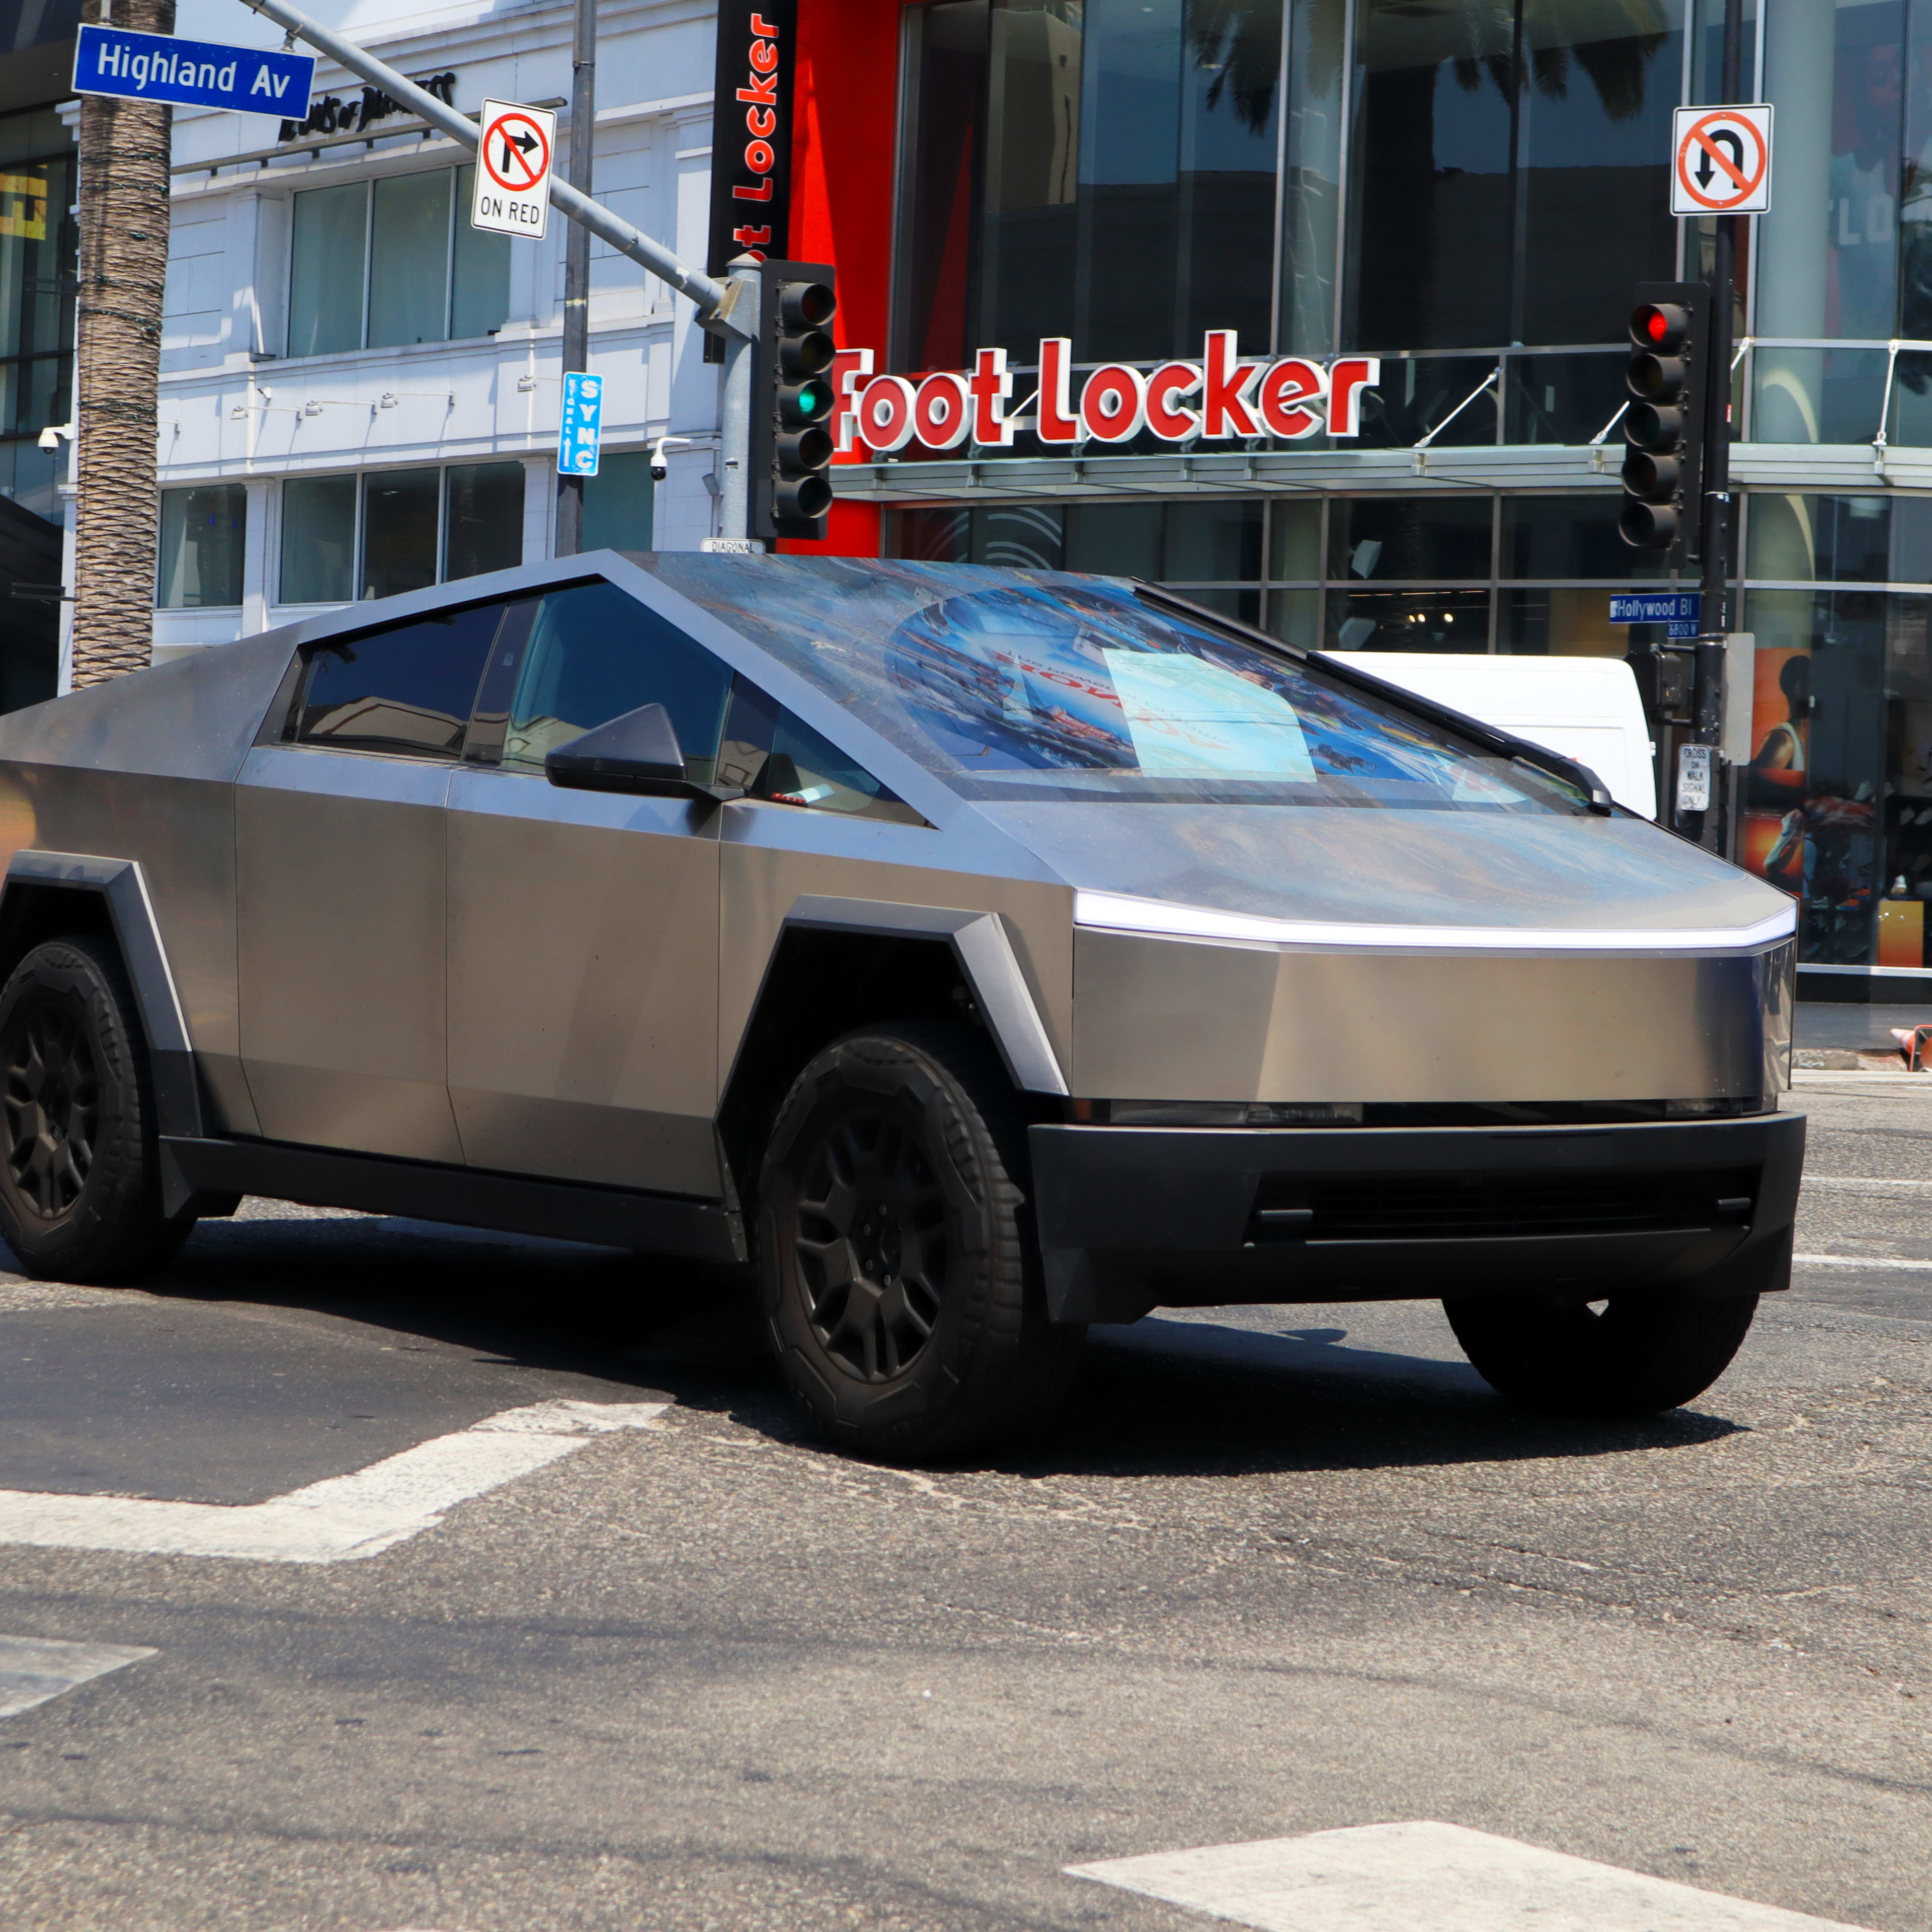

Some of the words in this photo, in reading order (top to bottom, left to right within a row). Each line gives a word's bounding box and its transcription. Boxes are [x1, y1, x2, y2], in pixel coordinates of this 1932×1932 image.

[97, 42, 237, 92] Highland
[250, 64, 291, 99] Av
[733, 13, 779, 202] Locker
[481, 196, 503, 218] ON
[509, 201, 540, 224] RED
[833, 347, 1014, 452] Foot
[1035, 329, 1381, 445] Locker
[565, 379, 577, 434] SIGNAL
[575, 380, 599, 469] SYNC
[711, 541, 755, 553] DIAGONAL
[1617, 598, 1676, 621] Hollywood
[1668, 623, 1689, 636] 6800
[1684, 748, 1706, 759] CROSS
[1691, 761, 1700, 769] ON
[1687, 771, 1704, 780] WALK
[1682, 783, 1706, 793] SIGNAL
[1683, 795, 1701, 805] ONLY
